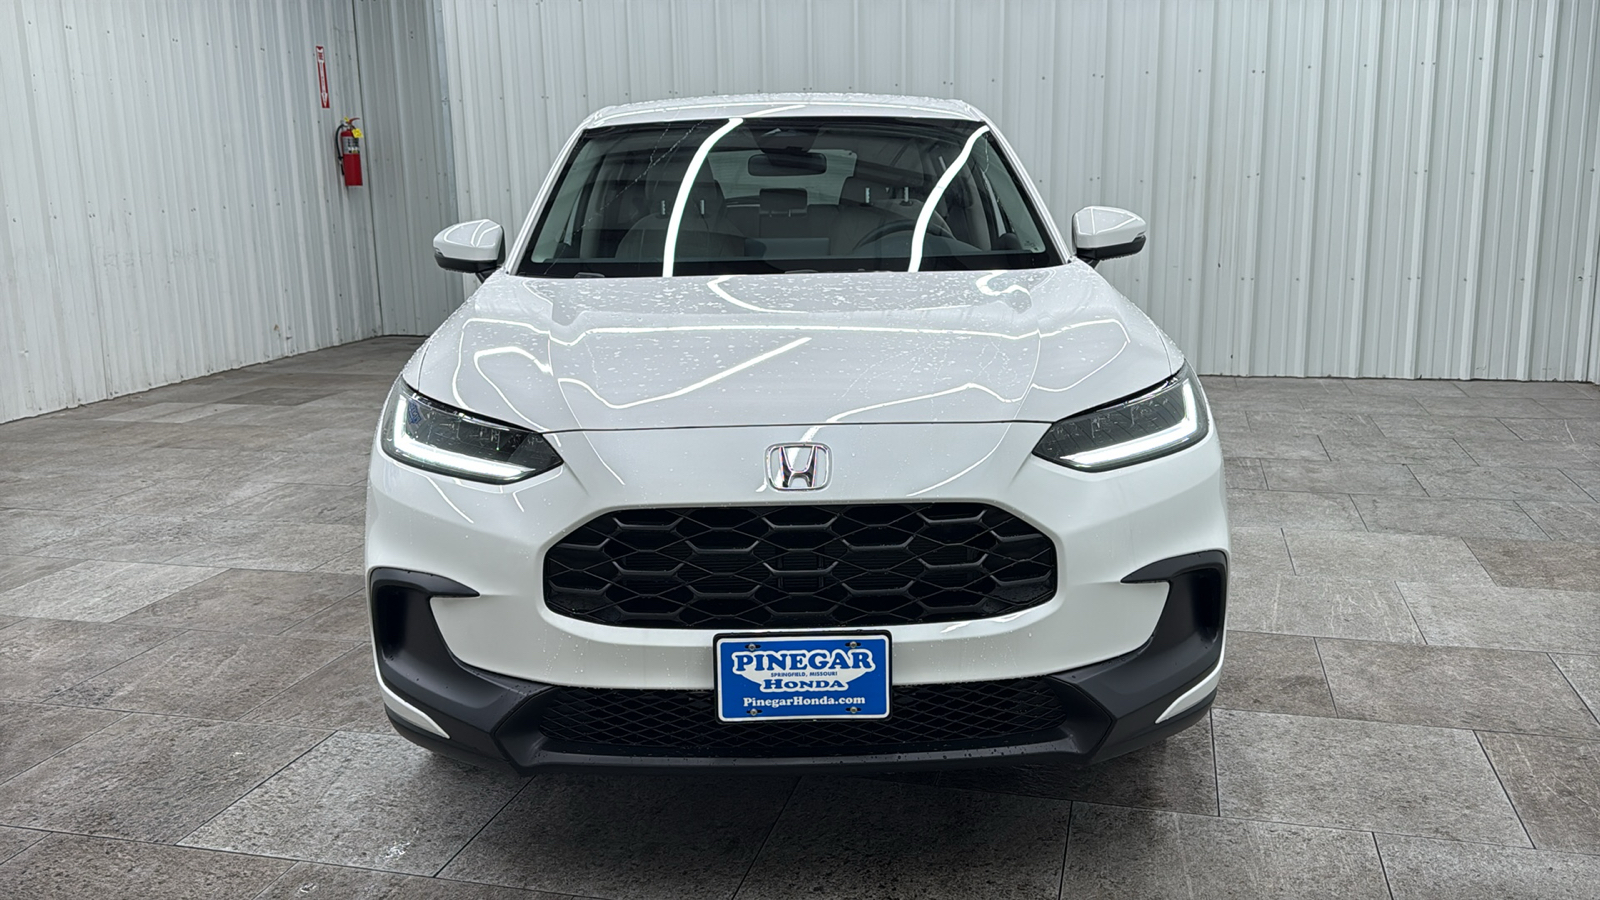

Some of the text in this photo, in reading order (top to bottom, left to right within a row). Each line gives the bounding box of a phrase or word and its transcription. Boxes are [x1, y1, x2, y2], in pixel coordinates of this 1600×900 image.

[735, 651, 872, 671] PINEGAR
[763, 679, 845, 689] HONDA
[743, 696, 865, 708] PinegarHonda.com
